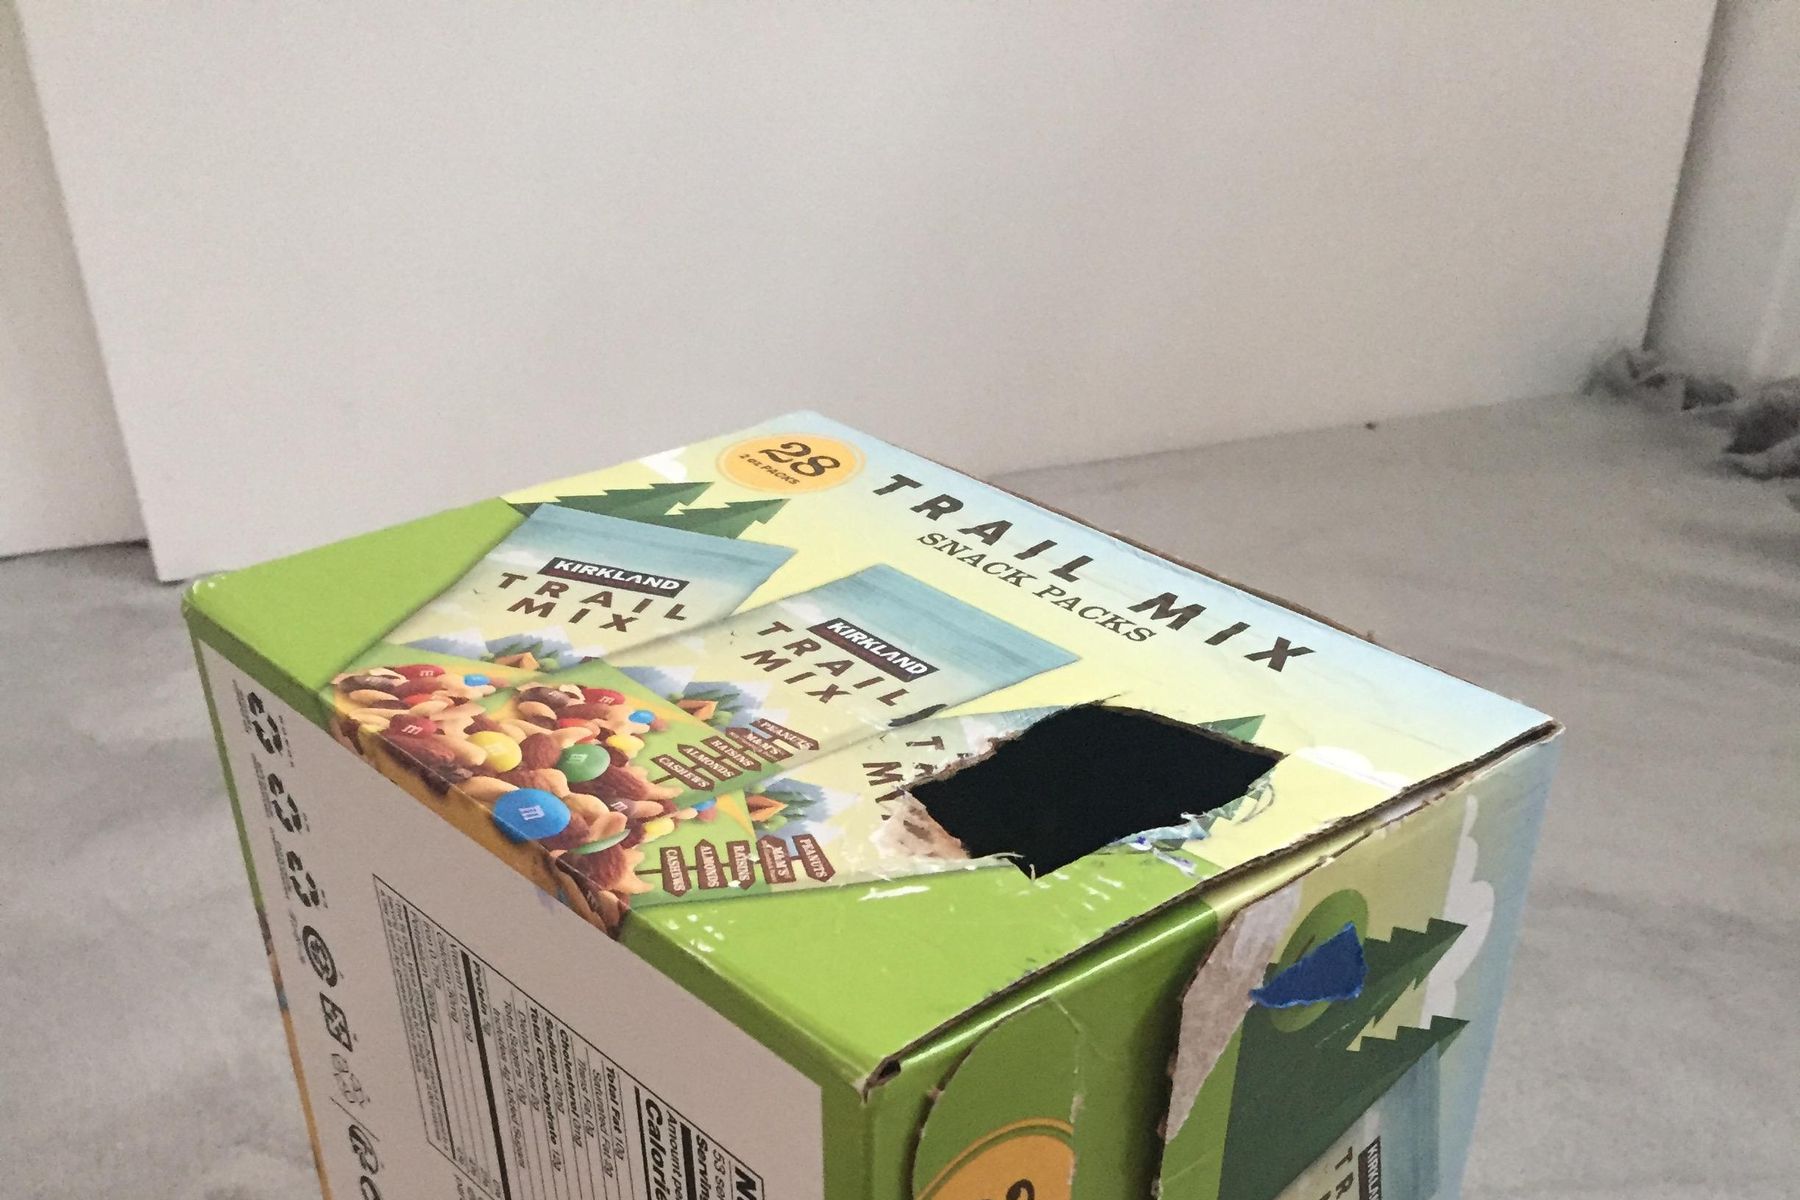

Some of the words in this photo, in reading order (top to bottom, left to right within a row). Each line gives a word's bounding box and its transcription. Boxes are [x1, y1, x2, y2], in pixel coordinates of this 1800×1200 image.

[759, 441, 840, 477] 28
[497, 572, 688, 621] TRAIL
[553, 559, 681, 591] KIRKLAND
[872, 474, 1094, 583] TRAIL
[1129, 591, 1316, 673] MIX
[917, 532, 1038, 588] SNACK
[1034, 584, 1158, 643] PACKS
[507, 597, 639, 632] MIX
[756, 621, 910, 707] TRAIL
[826, 621, 928, 676] KIRKLAND
[740, 649, 852, 704] MIX
[658, 756, 710, 788] CASHEWS
[683, 746, 735, 778] ALMONDS
[710, 738, 755, 768] RAISINS
[665, 849, 686, 892] CASHEWS
[700, 845, 720, 889] ALMONDS
[799, 837, 828, 879] PEANUTS
[471, 958, 489, 1018] Protein
[543, 1014, 559, 1076] Sodium
[528, 1003, 542, 1046] Total
[535, 1044, 558, 1148] Carbohydrate
[558, 1026, 579, 1118] Cholesterol
[605, 1062, 618, 1107] Total
[591, 1067, 608, 1136] Saturated
[610, 1104, 622, 1135] Fat
[665, 1109, 682, 1179] Amount
[712, 1147, 726, 1177] 53
